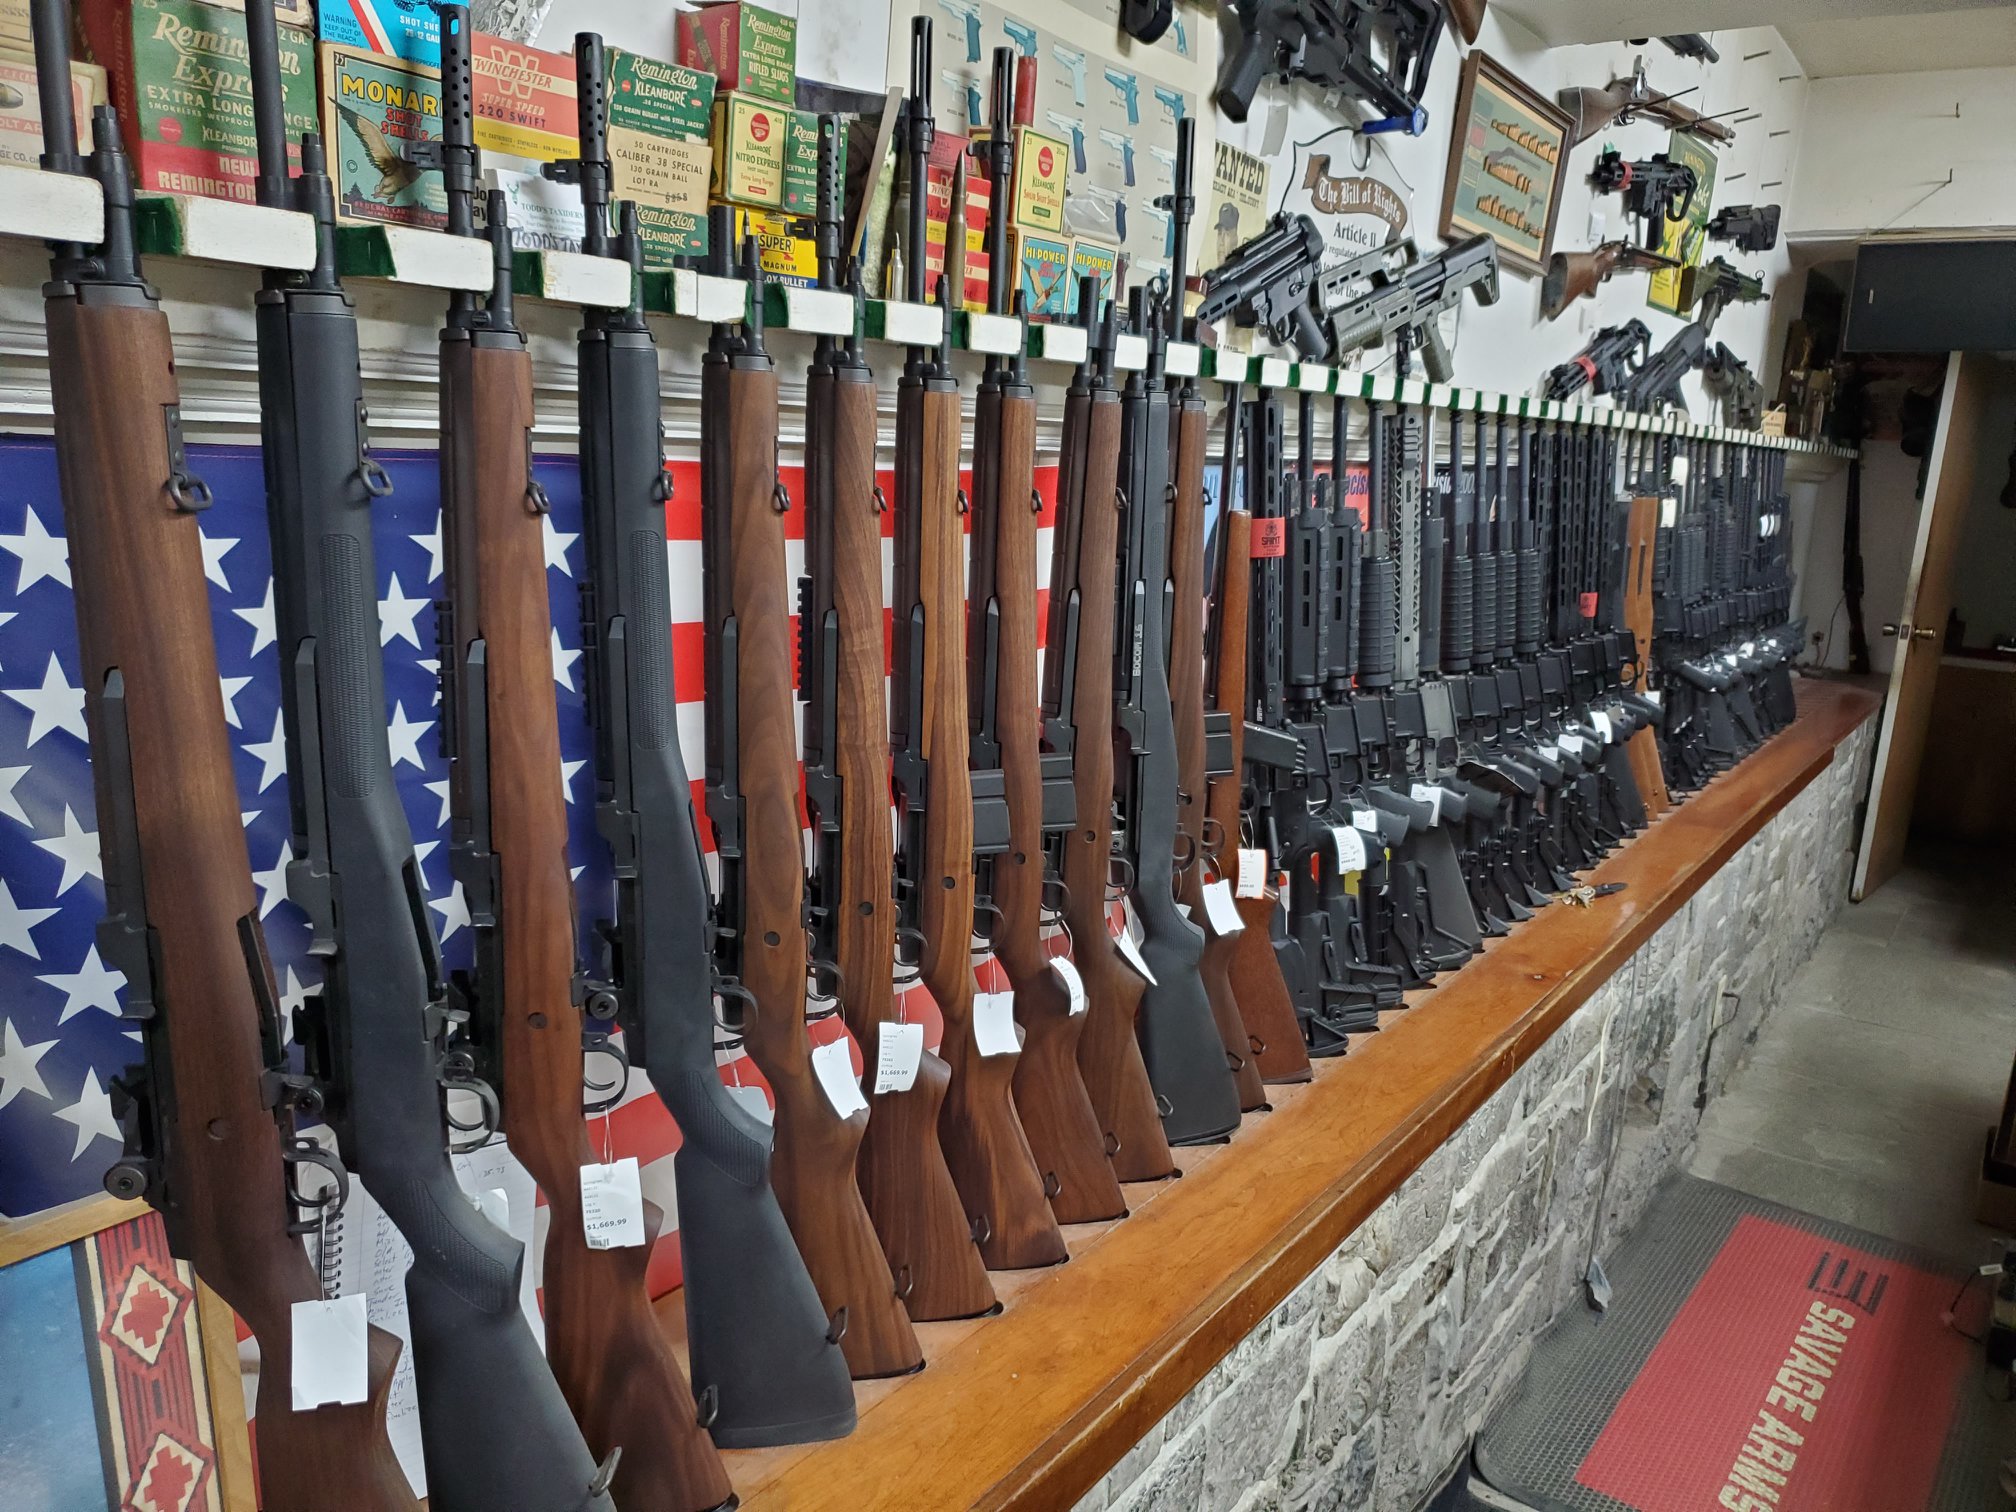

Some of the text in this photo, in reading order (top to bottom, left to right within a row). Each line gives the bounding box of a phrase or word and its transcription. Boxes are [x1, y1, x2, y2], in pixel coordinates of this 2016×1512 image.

[323, 13, 357, 28] WARNING
[324, 24, 339, 33] KEEP
[340, 27, 352, 35] OUT
[400, 15, 439, 32] SHOT SHE
[747, 14, 792, 42] Remington
[324, 30, 357, 43] THE REACH
[426, 32, 440, 44] GAU
[752, 35, 787, 58] Express
[742, 50, 760, 61] EXTRA
[761, 55, 775, 66] LONG
[474, 57, 552, 89] WINCHESTER
[631, 57, 697, 90] Remington
[748, 61, 789, 83] RIFLED SLUGS
[342, 73, 443, 117] MONAR
[634, 79, 688, 108] KLEANBORE
[147, 85, 313, 130] EXTRA LONG NGE
[482, 92, 545, 116] SUPER SPEED
[478, 104, 547, 128] 220 SWIFT
[203, 125, 257, 148] KLEANBOR
[634, 140, 689, 159] 50 CARTRIDGES
[616, 148, 651, 164] CALIBER
[672, 160, 704, 175] SPECIAL
[735, 151, 780, 170] NITRO EXPRESS
[630, 164, 688, 183] 130 GRAIN BALL
[632, 176, 659, 188] LOT RA
[1319, 177, 1401, 223] The Bill of Rights
[759, 235, 792, 252] SUPER
[1333, 221, 1368, 246] Article
[1329, 244, 1357, 259] regulated
[763, 260, 797, 272] MAGNUM
[1345, 285, 1358, 299] the
[586, 1218, 627, 1231] $1,669.99
[1766, 1300, 1857, 1423] SAVAGE
